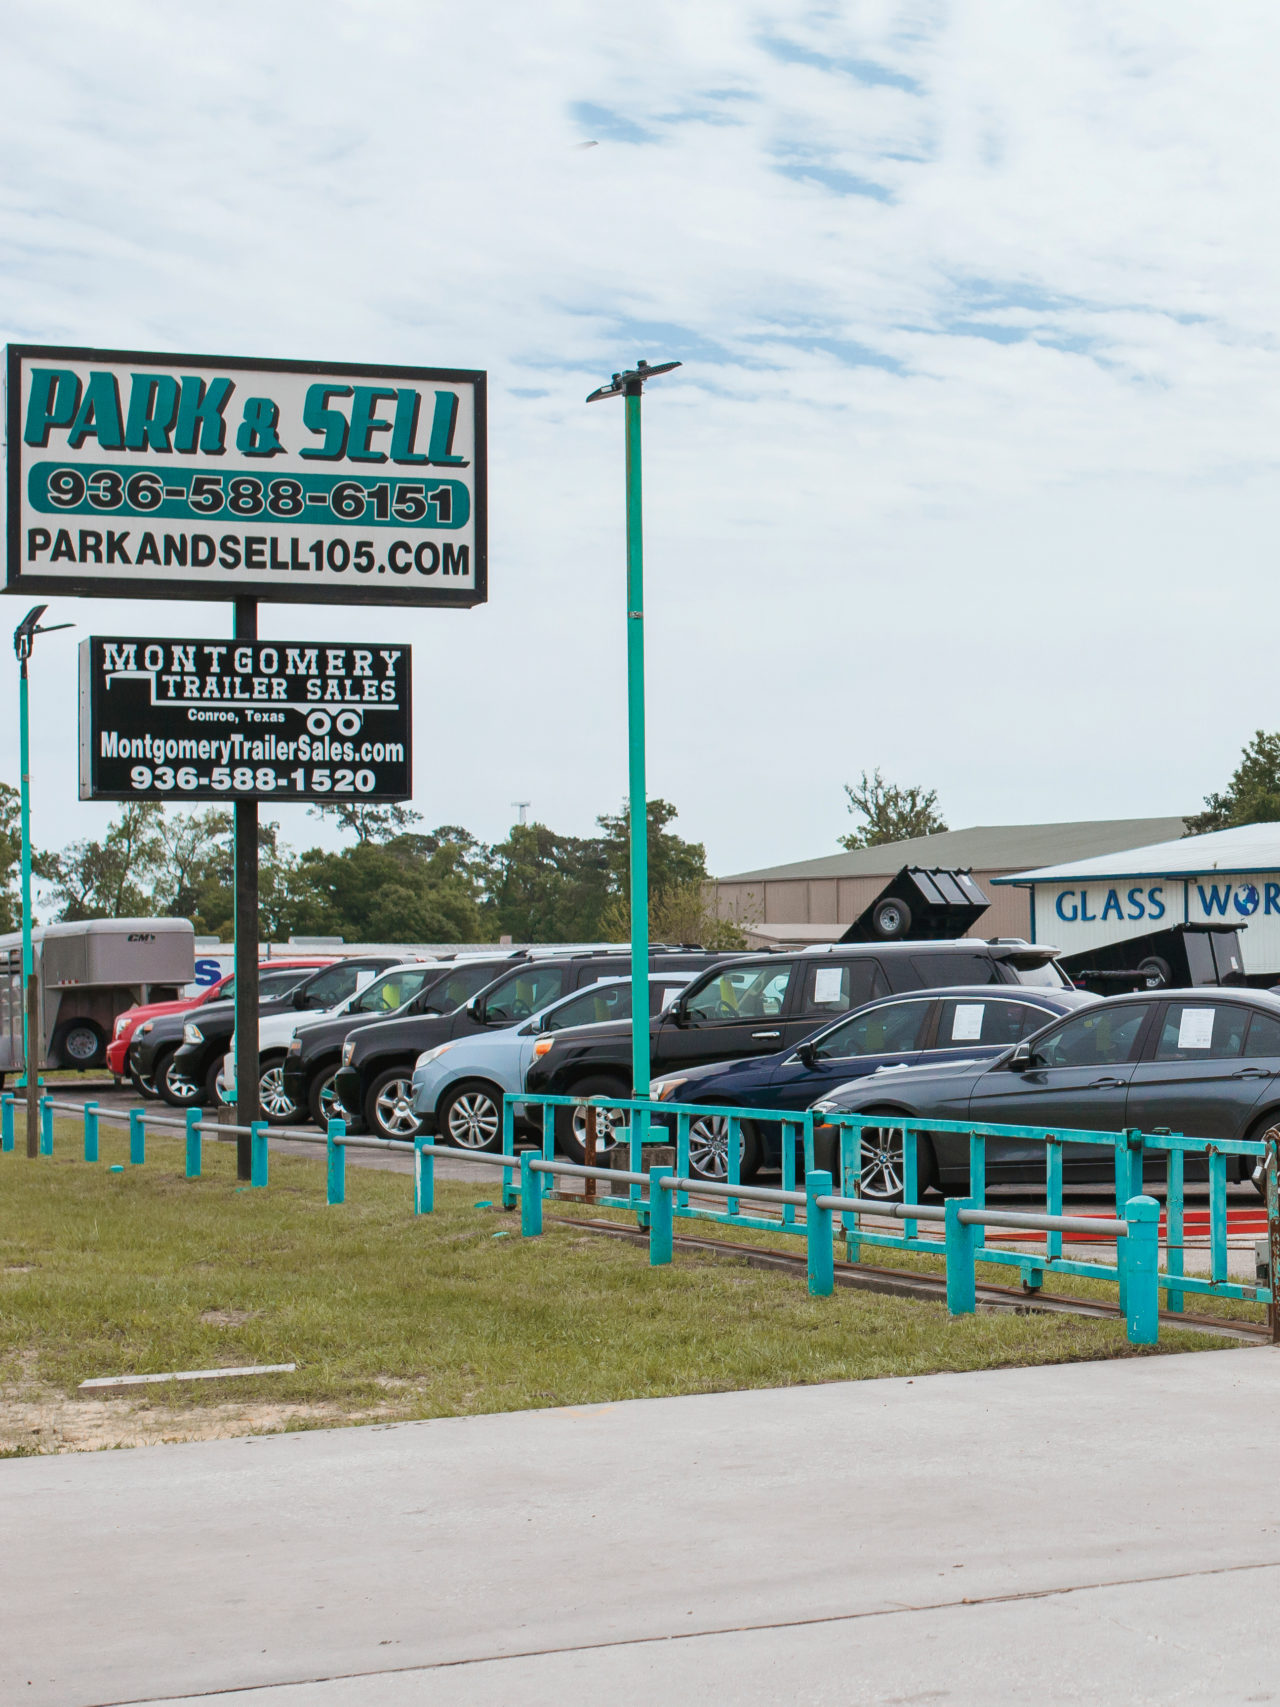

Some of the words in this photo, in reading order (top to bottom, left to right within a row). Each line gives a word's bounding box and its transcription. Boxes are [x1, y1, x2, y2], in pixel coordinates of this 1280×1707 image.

[24, 367, 236, 456] PARK
[236, 397, 288, 457] &
[299, 383, 470, 468] SELL
[47, 468, 454, 523] 936-588-6151
[27, 527, 470, 576] PARKANDSELL105.COM
[103, 643, 402, 677] MONTGOMERY
[162, 675, 287, 700] TRAILER
[306, 679, 397, 702] SALES
[187, 708, 239, 724] Conroe,
[244, 709, 285, 724] Texas
[100, 731, 404, 766] MontgomeryTrailerSales.com
[130, 766, 376, 793] 936-588-1520
[1055, 887, 1166, 922] GLASS
